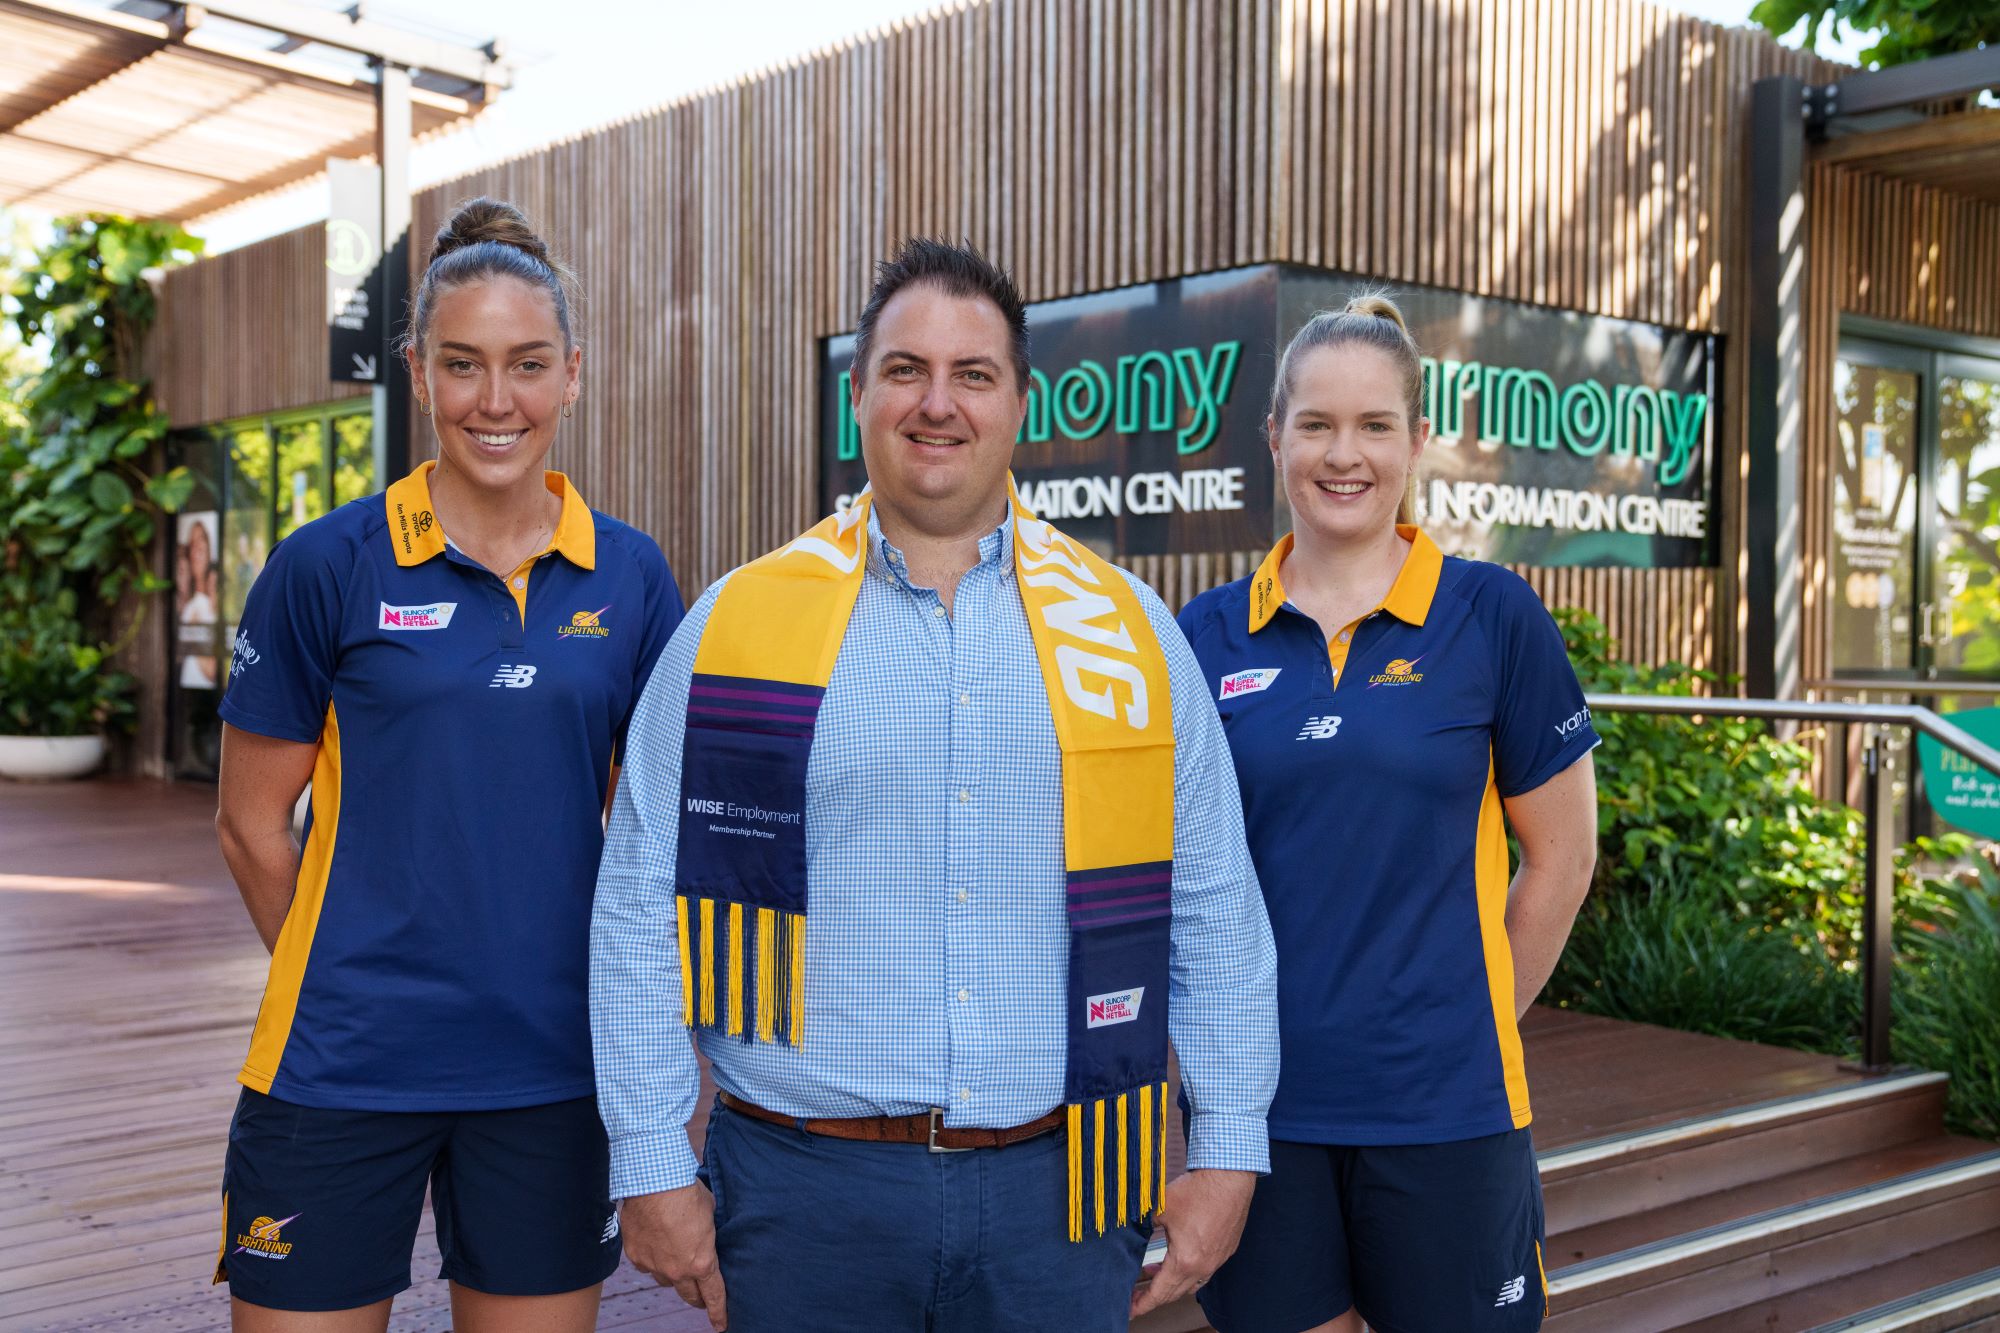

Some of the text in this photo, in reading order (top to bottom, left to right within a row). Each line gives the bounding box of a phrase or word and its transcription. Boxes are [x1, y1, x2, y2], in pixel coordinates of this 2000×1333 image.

[1125, 467, 1245, 516] CENTRE
[1430, 479, 1617, 532] INFORMATION
[1618, 494, 1706, 538] CENTRE
[399, 515, 407, 531] Mills
[411, 512, 421, 538] TOYOTA
[402, 532, 412, 554] Toyota
[402, 607, 438, 616] SUNCORP
[403, 619, 440, 627] NETBALL
[558, 625, 610, 637] LIGHTNING
[1236, 672, 1264, 681] SUNCORP
[1368, 673, 1424, 684] LIGHTNING
[1235, 679, 1255, 687] SUPER
[1235, 683, 1262, 693] NETBALL
[687, 798, 801, 825] WISE Employment
[708, 824, 777, 839] Membership Partner
[1105, 994, 1132, 1006] SUNCORP
[1105, 1003, 1126, 1013] SUPER
[1105, 1009, 1133, 1020] NETBALL
[237, 1233, 293, 1255] LIGHTNING
